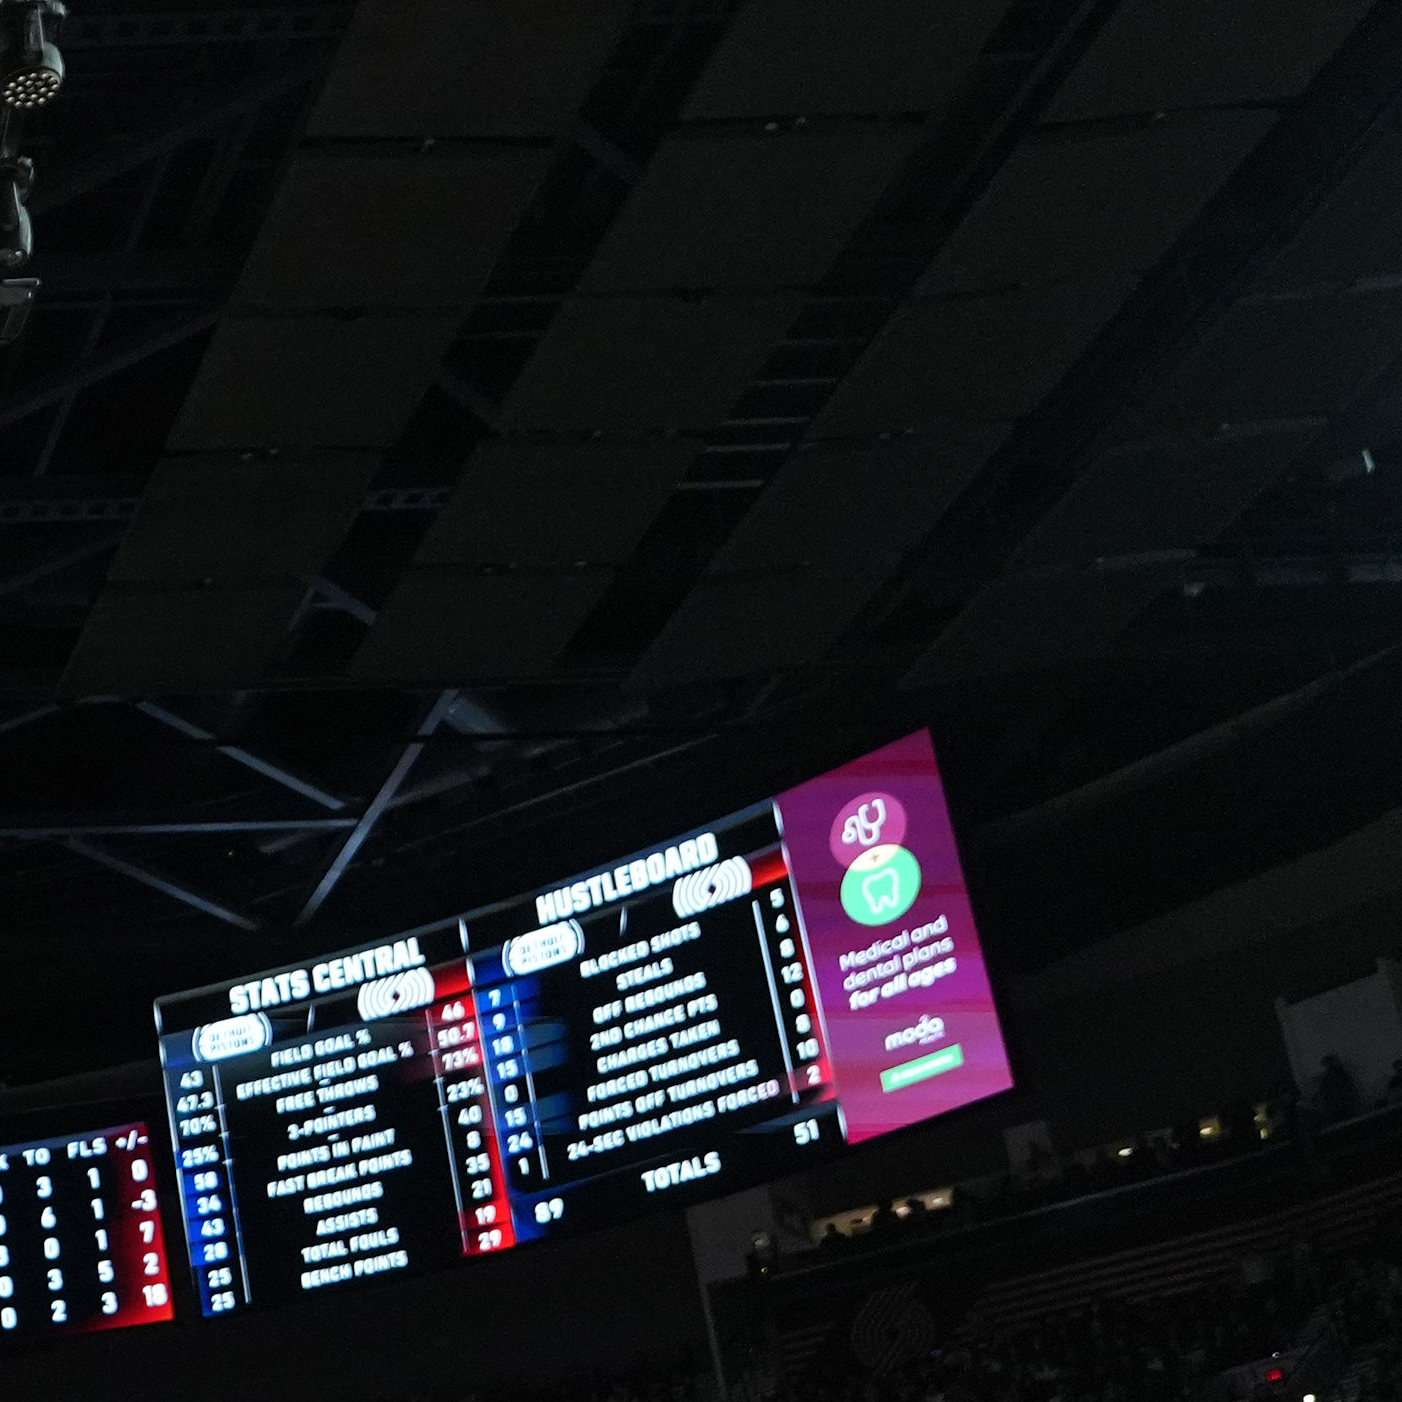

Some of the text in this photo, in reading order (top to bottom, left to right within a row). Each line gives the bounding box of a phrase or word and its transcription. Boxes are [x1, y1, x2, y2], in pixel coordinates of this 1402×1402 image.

[535, 832, 719, 924] HUSTLEBOARD
[839, 914, 948, 971] Medical and
[229, 937, 426, 1014] STATS CENTRAL
[843, 937, 954, 991] dental plans
[849, 957, 957, 1010] for all ages
[276, 1075, 379, 1114] FREE THROWS
[22, 1147, 51, 1166] TO
[67, 1137, 107, 1159] FLS
[115, 1130, 148, 1151] +/-
[794, 1118, 819, 1146] 51
[642, 1151, 721, 1192] TOTALS
[316, 1207, 378, 1236] ASSISTS
[535, 1198, 564, 1224] 89
[301, 1250, 408, 1289] BENCH POINTS
